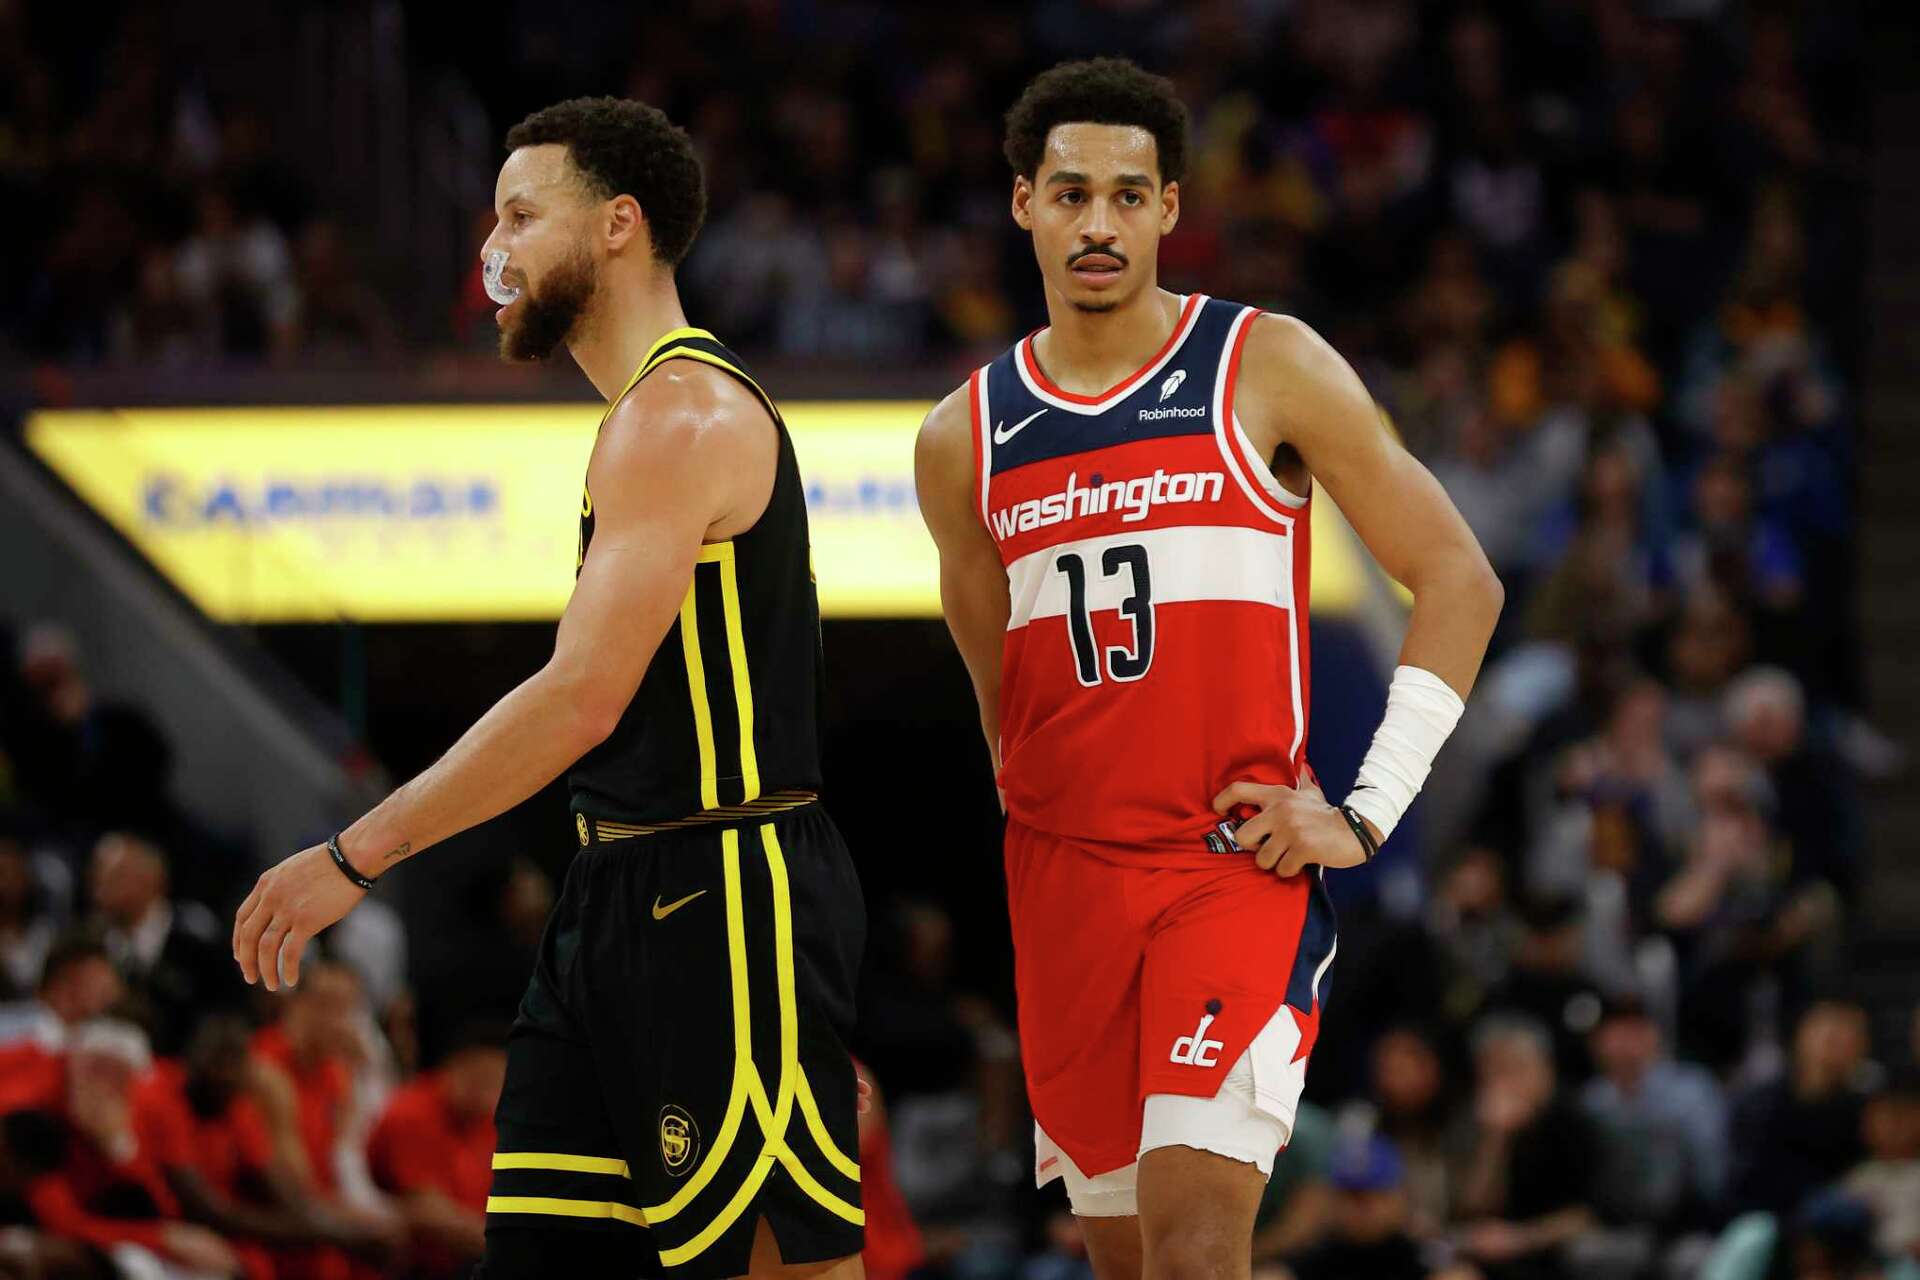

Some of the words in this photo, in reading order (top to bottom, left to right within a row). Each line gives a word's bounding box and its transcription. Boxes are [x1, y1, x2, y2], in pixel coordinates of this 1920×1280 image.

[1139, 406, 1205, 421] Robinhood
[992, 469, 1224, 541] washington
[1054, 542, 1155, 687] 13
